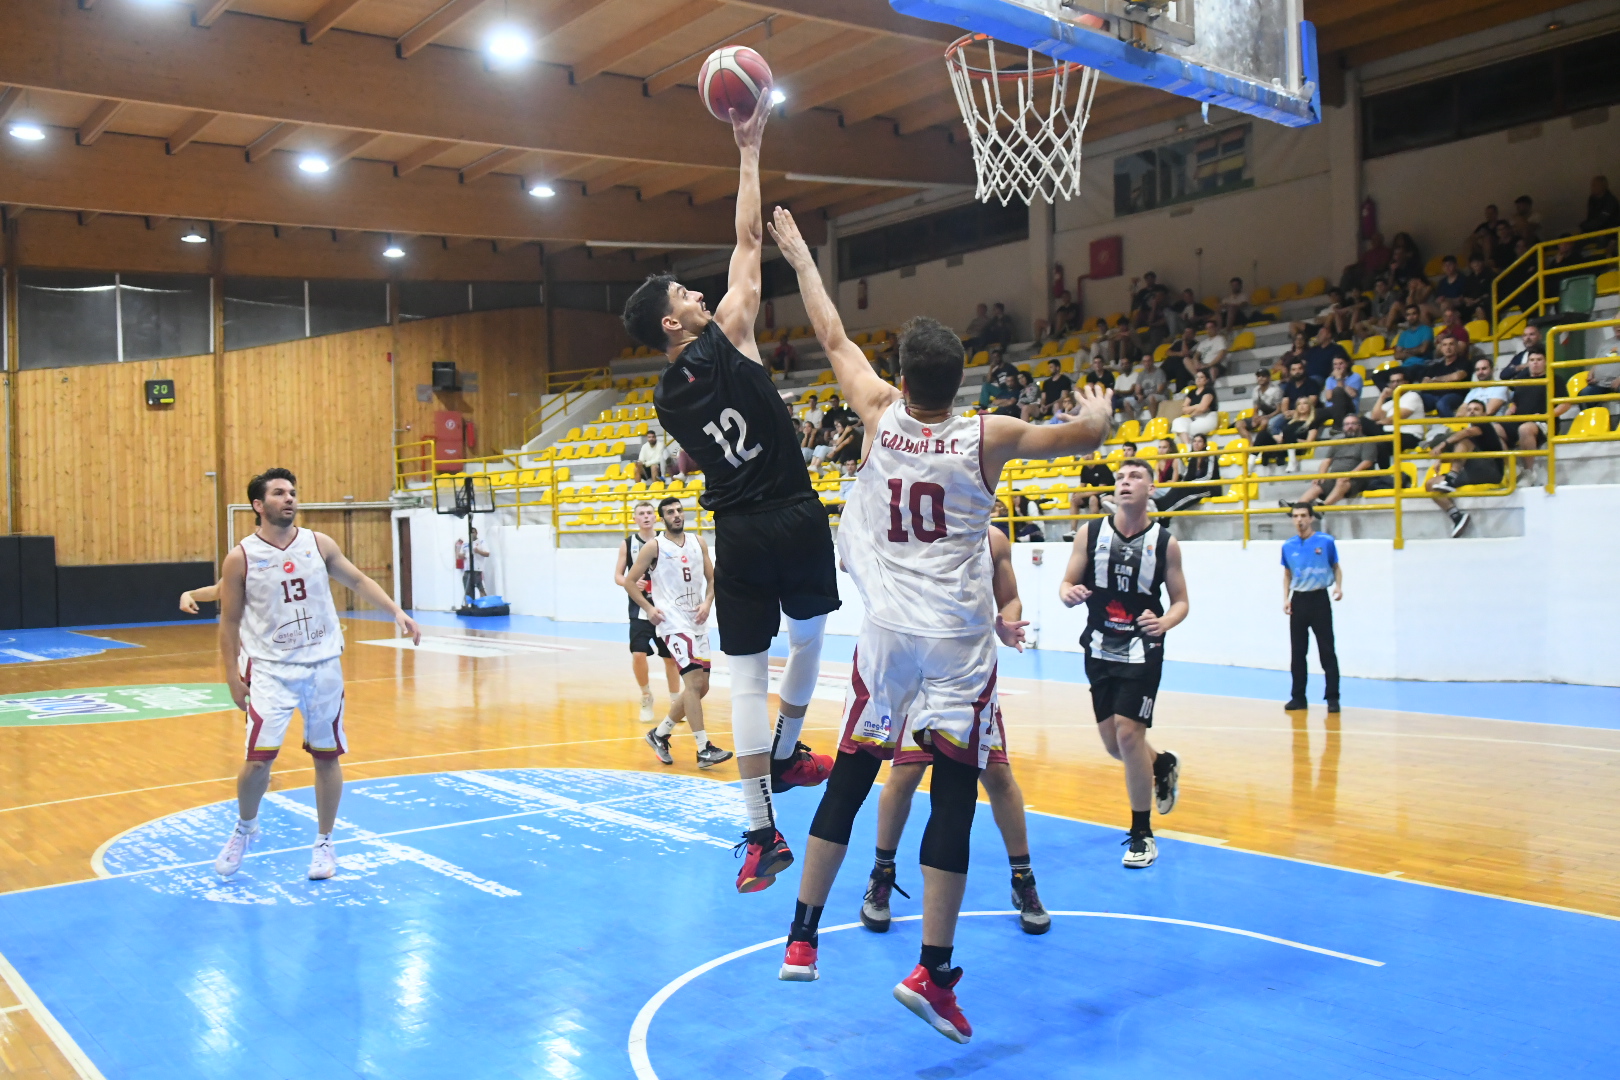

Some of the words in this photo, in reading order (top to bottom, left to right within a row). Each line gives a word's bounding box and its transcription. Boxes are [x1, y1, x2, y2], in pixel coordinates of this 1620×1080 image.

[153, 384, 168, 395] 20
[702, 407, 763, 469] 12
[935, 438, 964, 456] B.C.
[887, 478, 947, 543] 10
[682, 567, 692, 582] 6
[1116, 575, 1130, 593] 10
[281, 577, 307, 604] 13
[1138, 695, 1153, 719] 10
